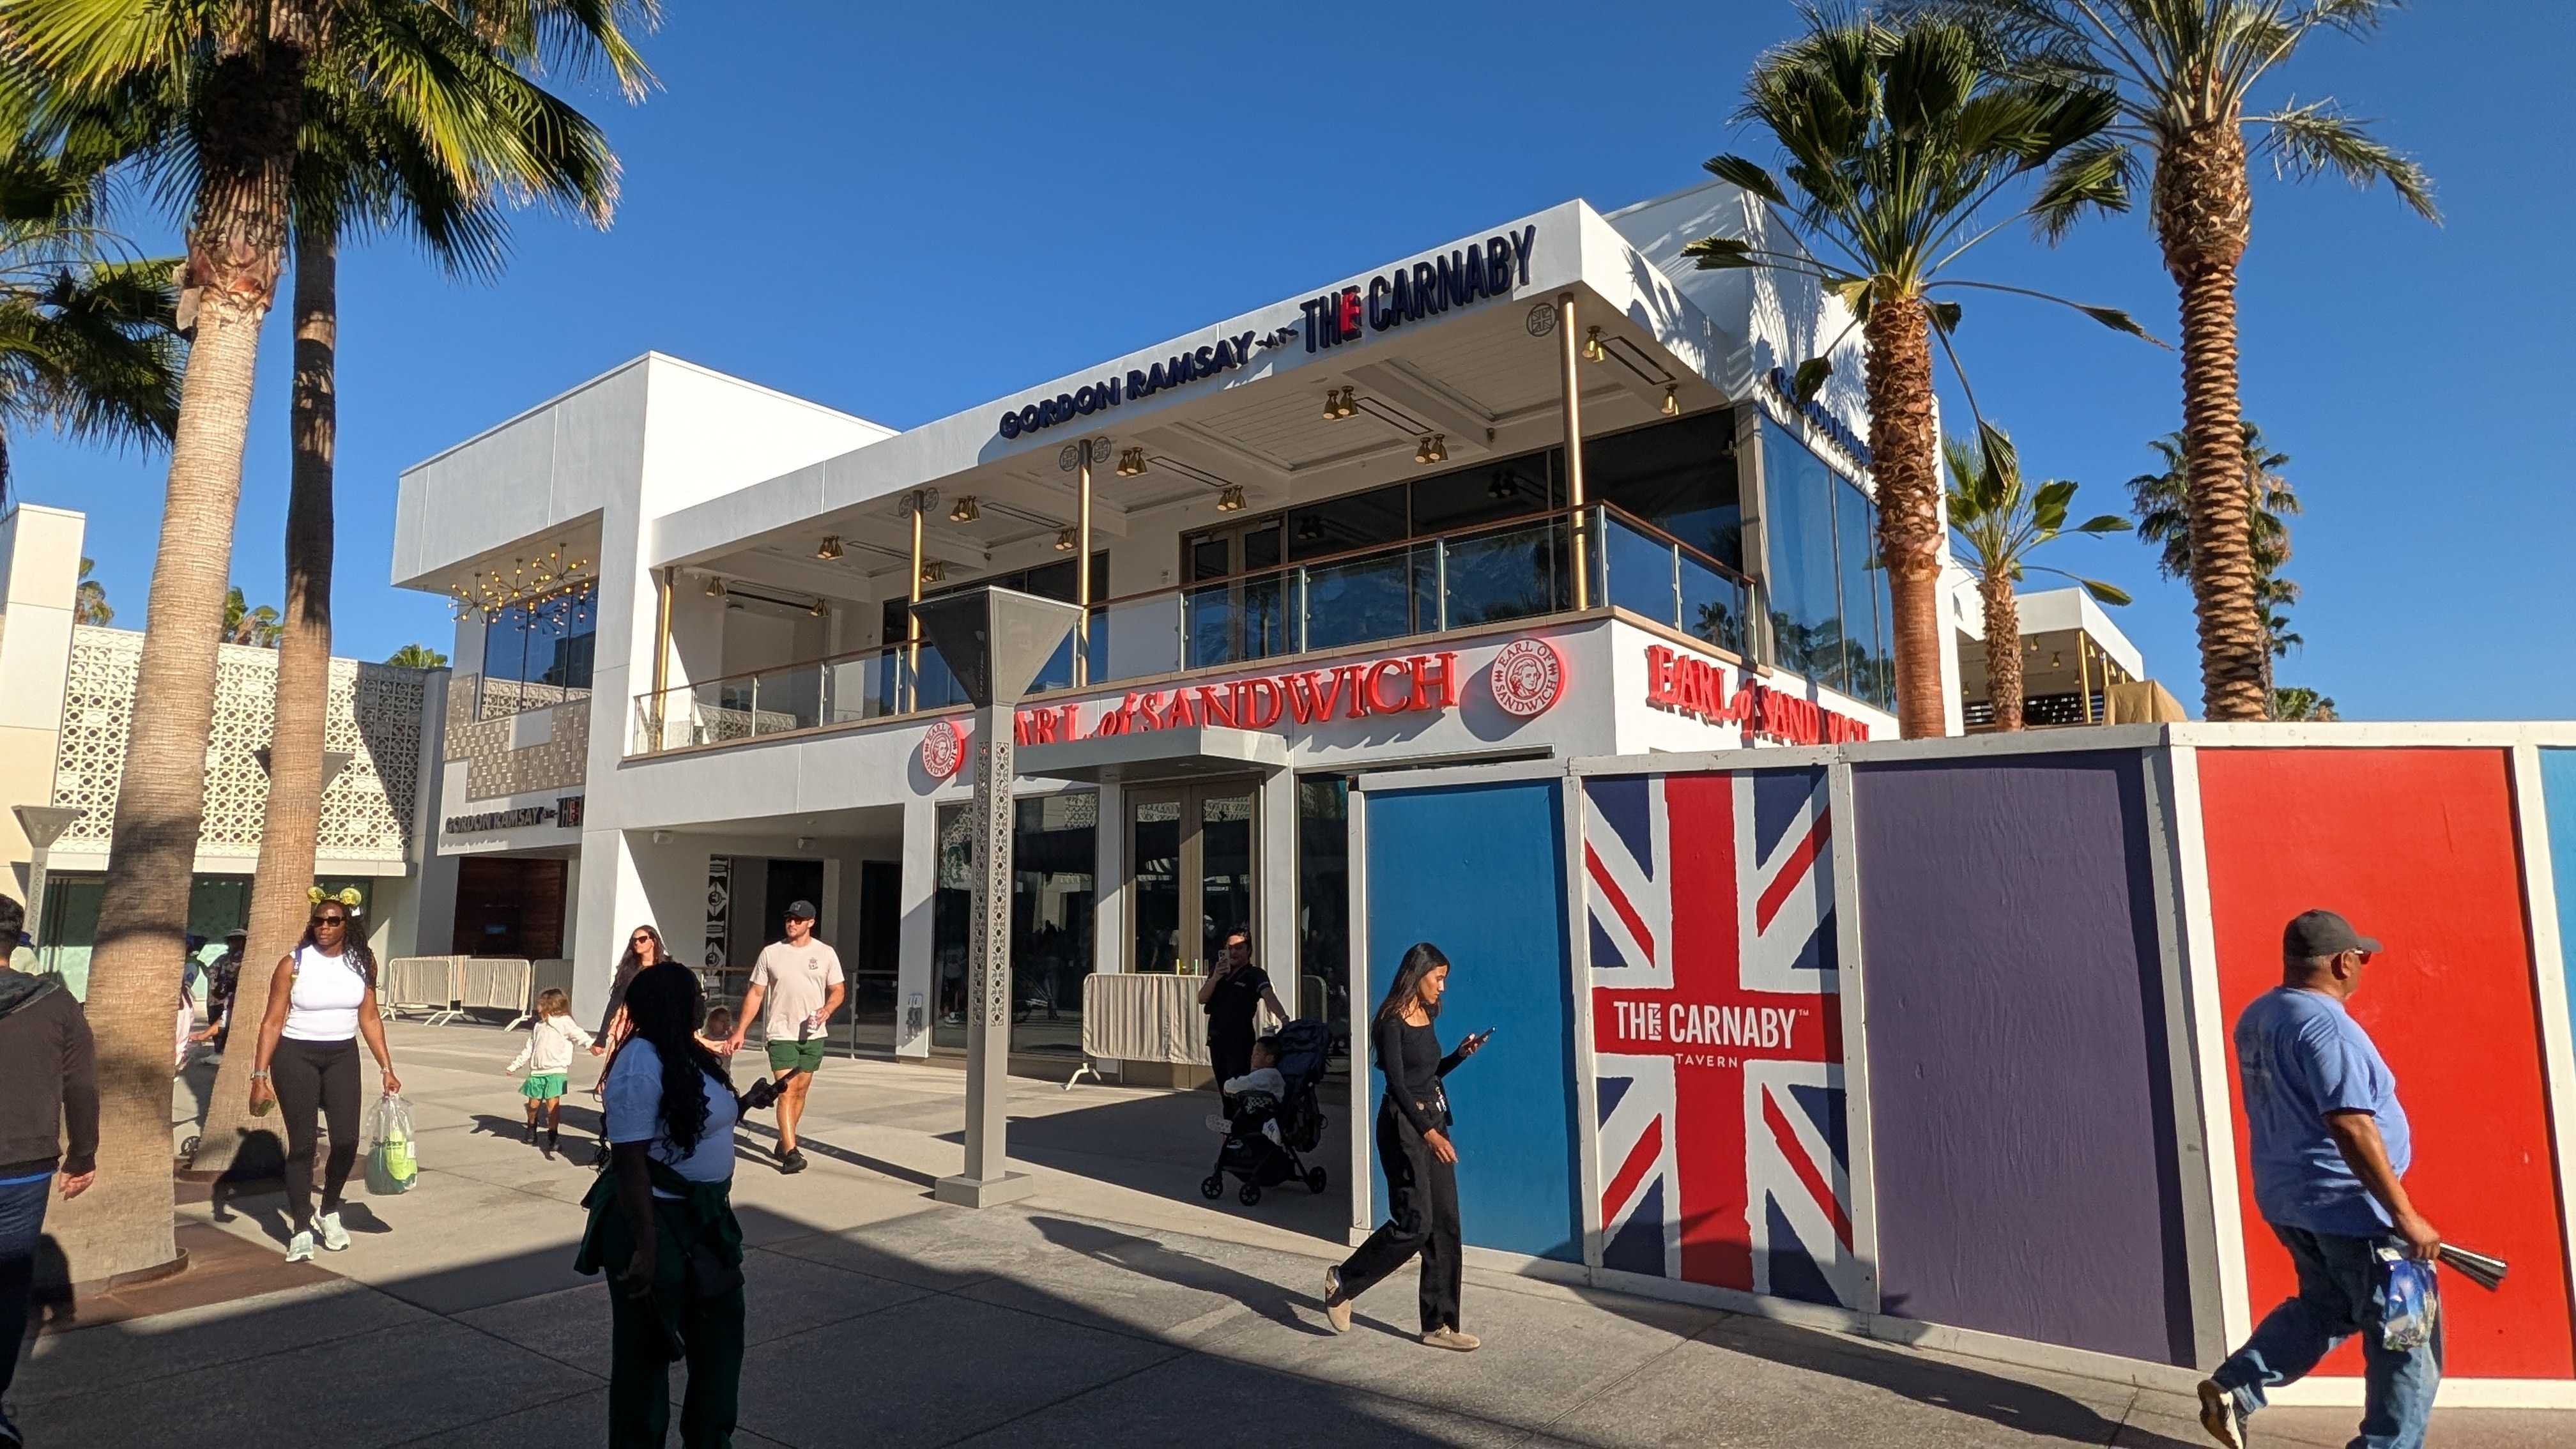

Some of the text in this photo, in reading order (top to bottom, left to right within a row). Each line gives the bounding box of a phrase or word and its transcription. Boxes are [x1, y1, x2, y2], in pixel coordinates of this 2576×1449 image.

[999, 376, 1120, 440] GORDON
[1126, 330, 1256, 401] RAMSAY
[1300, 285, 1362, 353] THE
[1368, 224, 1537, 331] CARNABY
[1498, 641, 1554, 667] EARL OF
[1014, 704, 1093, 746] ARL
[1140, 651, 1459, 731] SANDWICH
[1496, 679, 1557, 712] SANDWICH
[1647, 644, 1736, 721] EARL
[445, 813, 493, 834] GORDON
[492, 806, 544, 831] RAMSAY
[1613, 1001, 1661, 1041] THE
[1668, 1003, 1795, 1049] CARNABY
[1675, 1053, 1738, 1068] TAVERN
